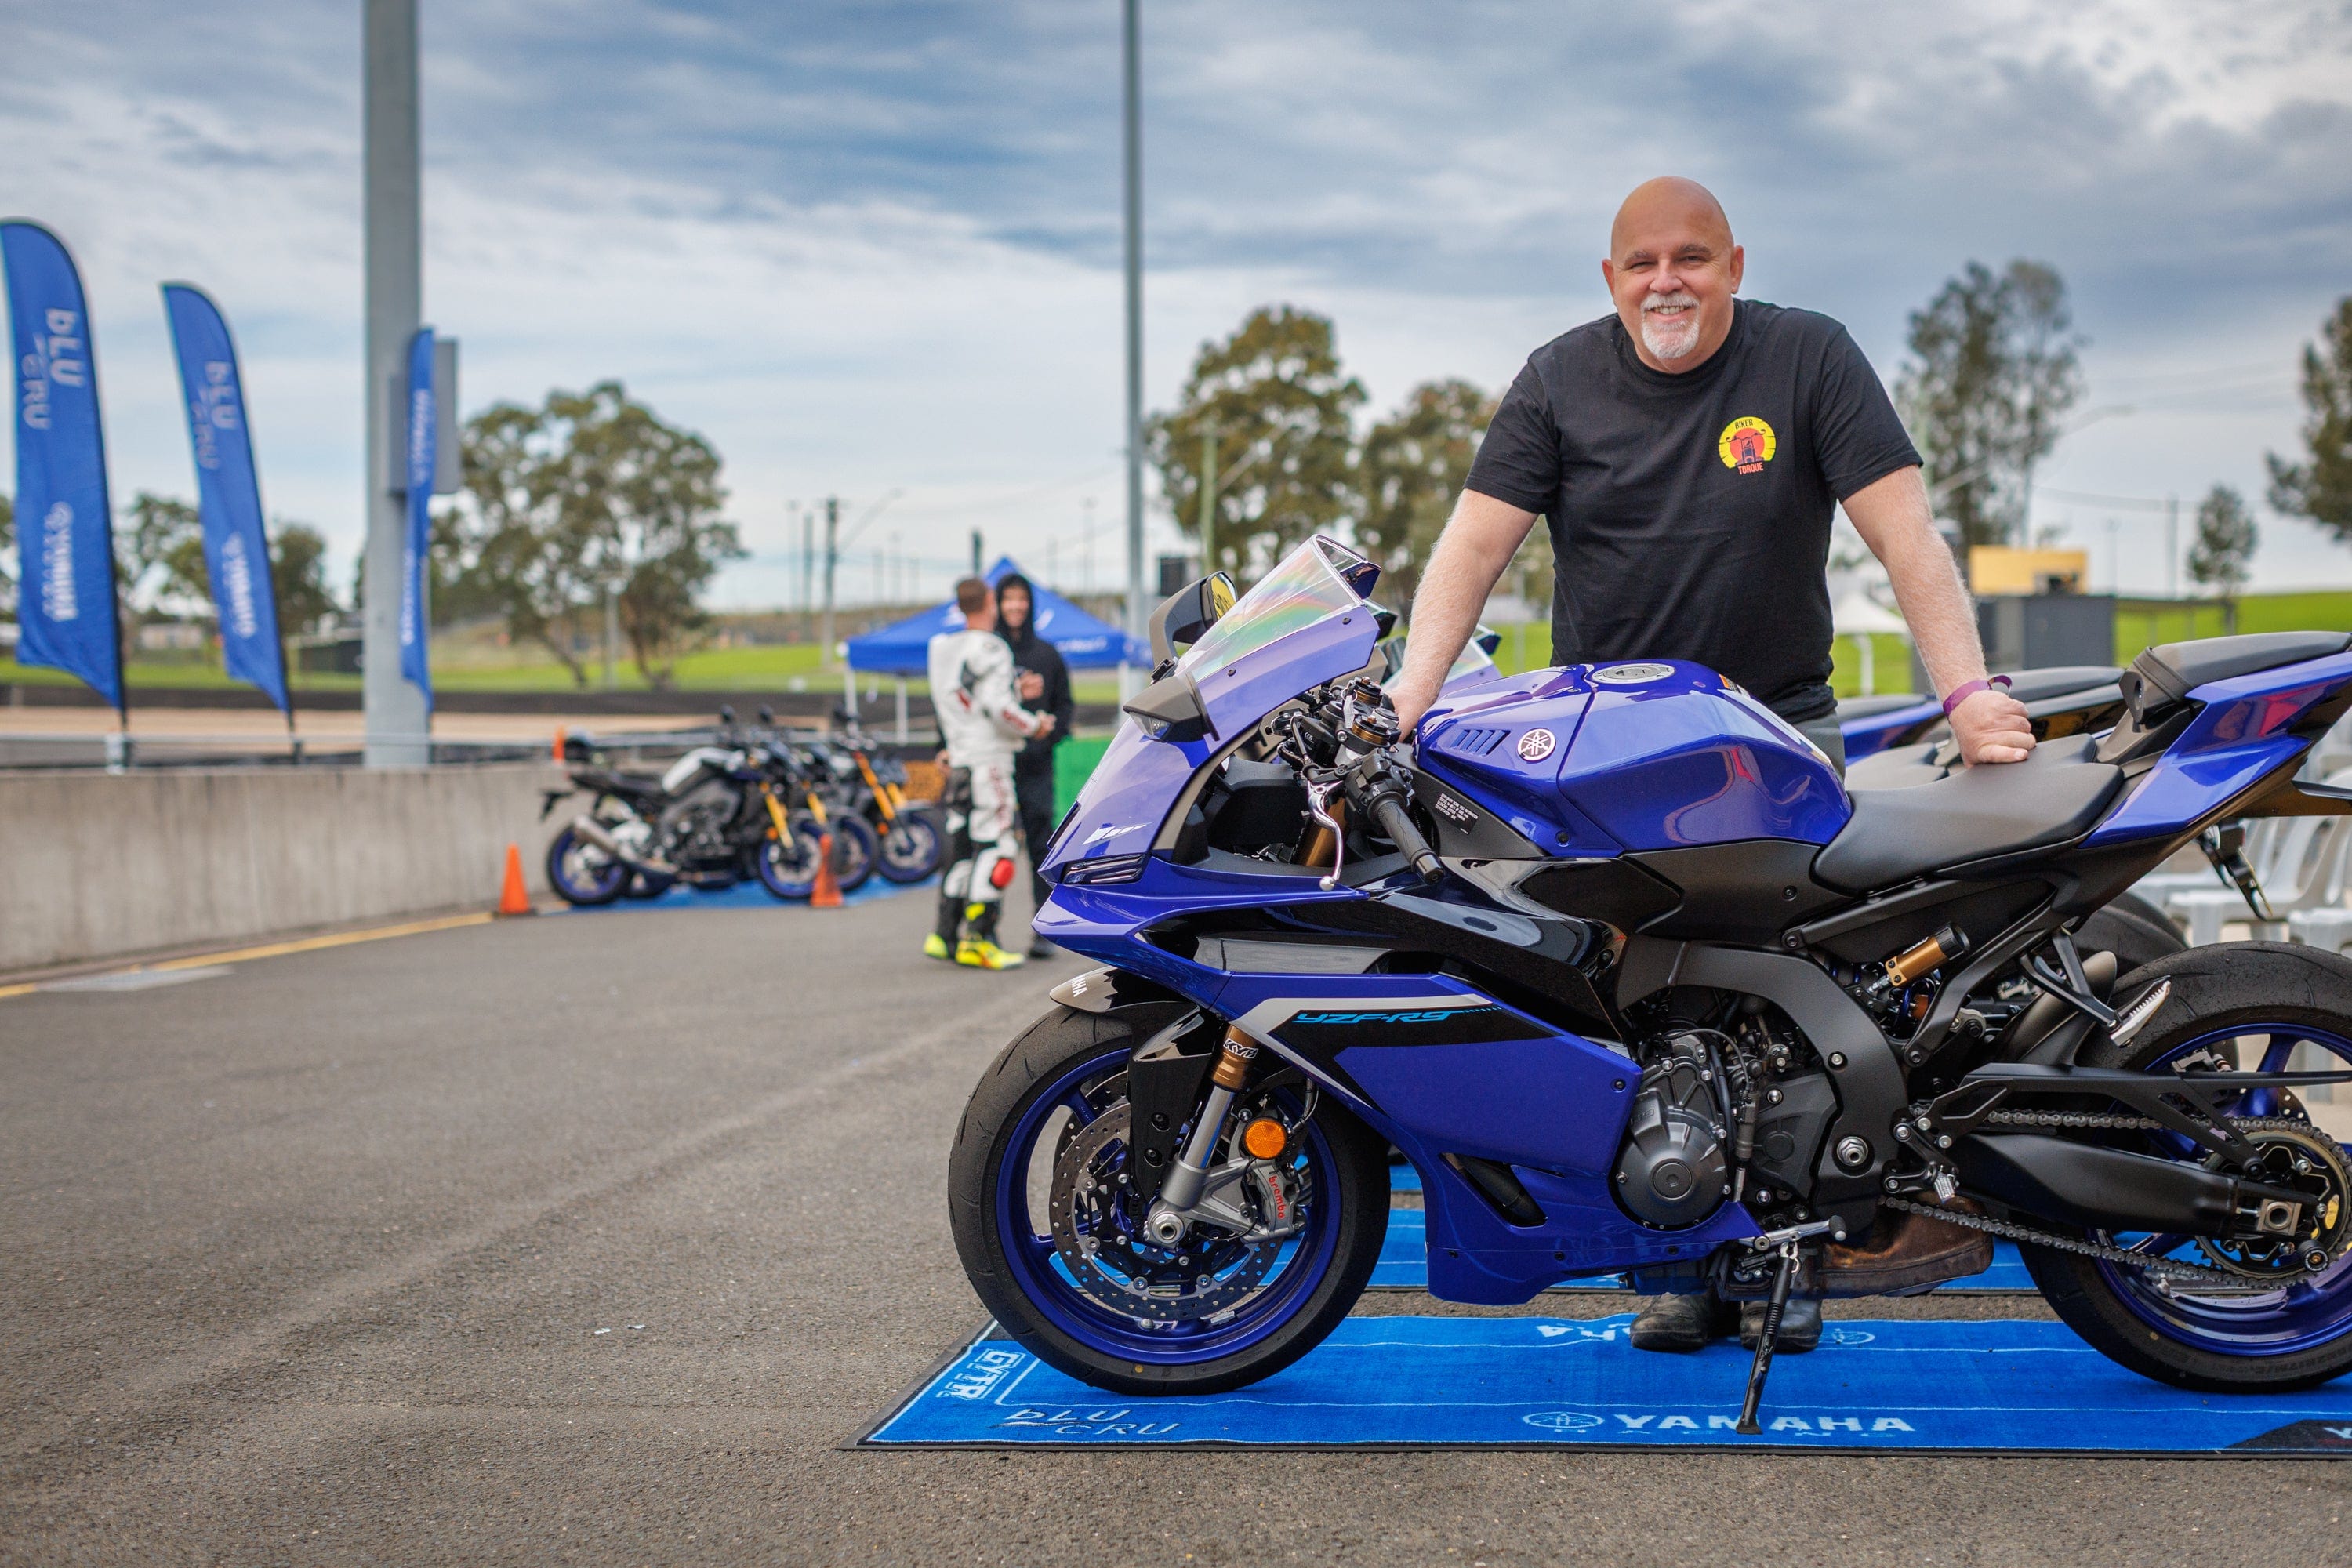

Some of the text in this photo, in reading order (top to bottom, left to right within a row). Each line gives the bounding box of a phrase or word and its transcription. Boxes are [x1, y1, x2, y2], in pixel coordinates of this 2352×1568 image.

[1734, 418, 1754, 429] BIKER
[1737, 462, 1764, 475] TORQUE
[1223, 1037, 1259, 1059] KYB
[1268, 1175, 1287, 1221] brembo
